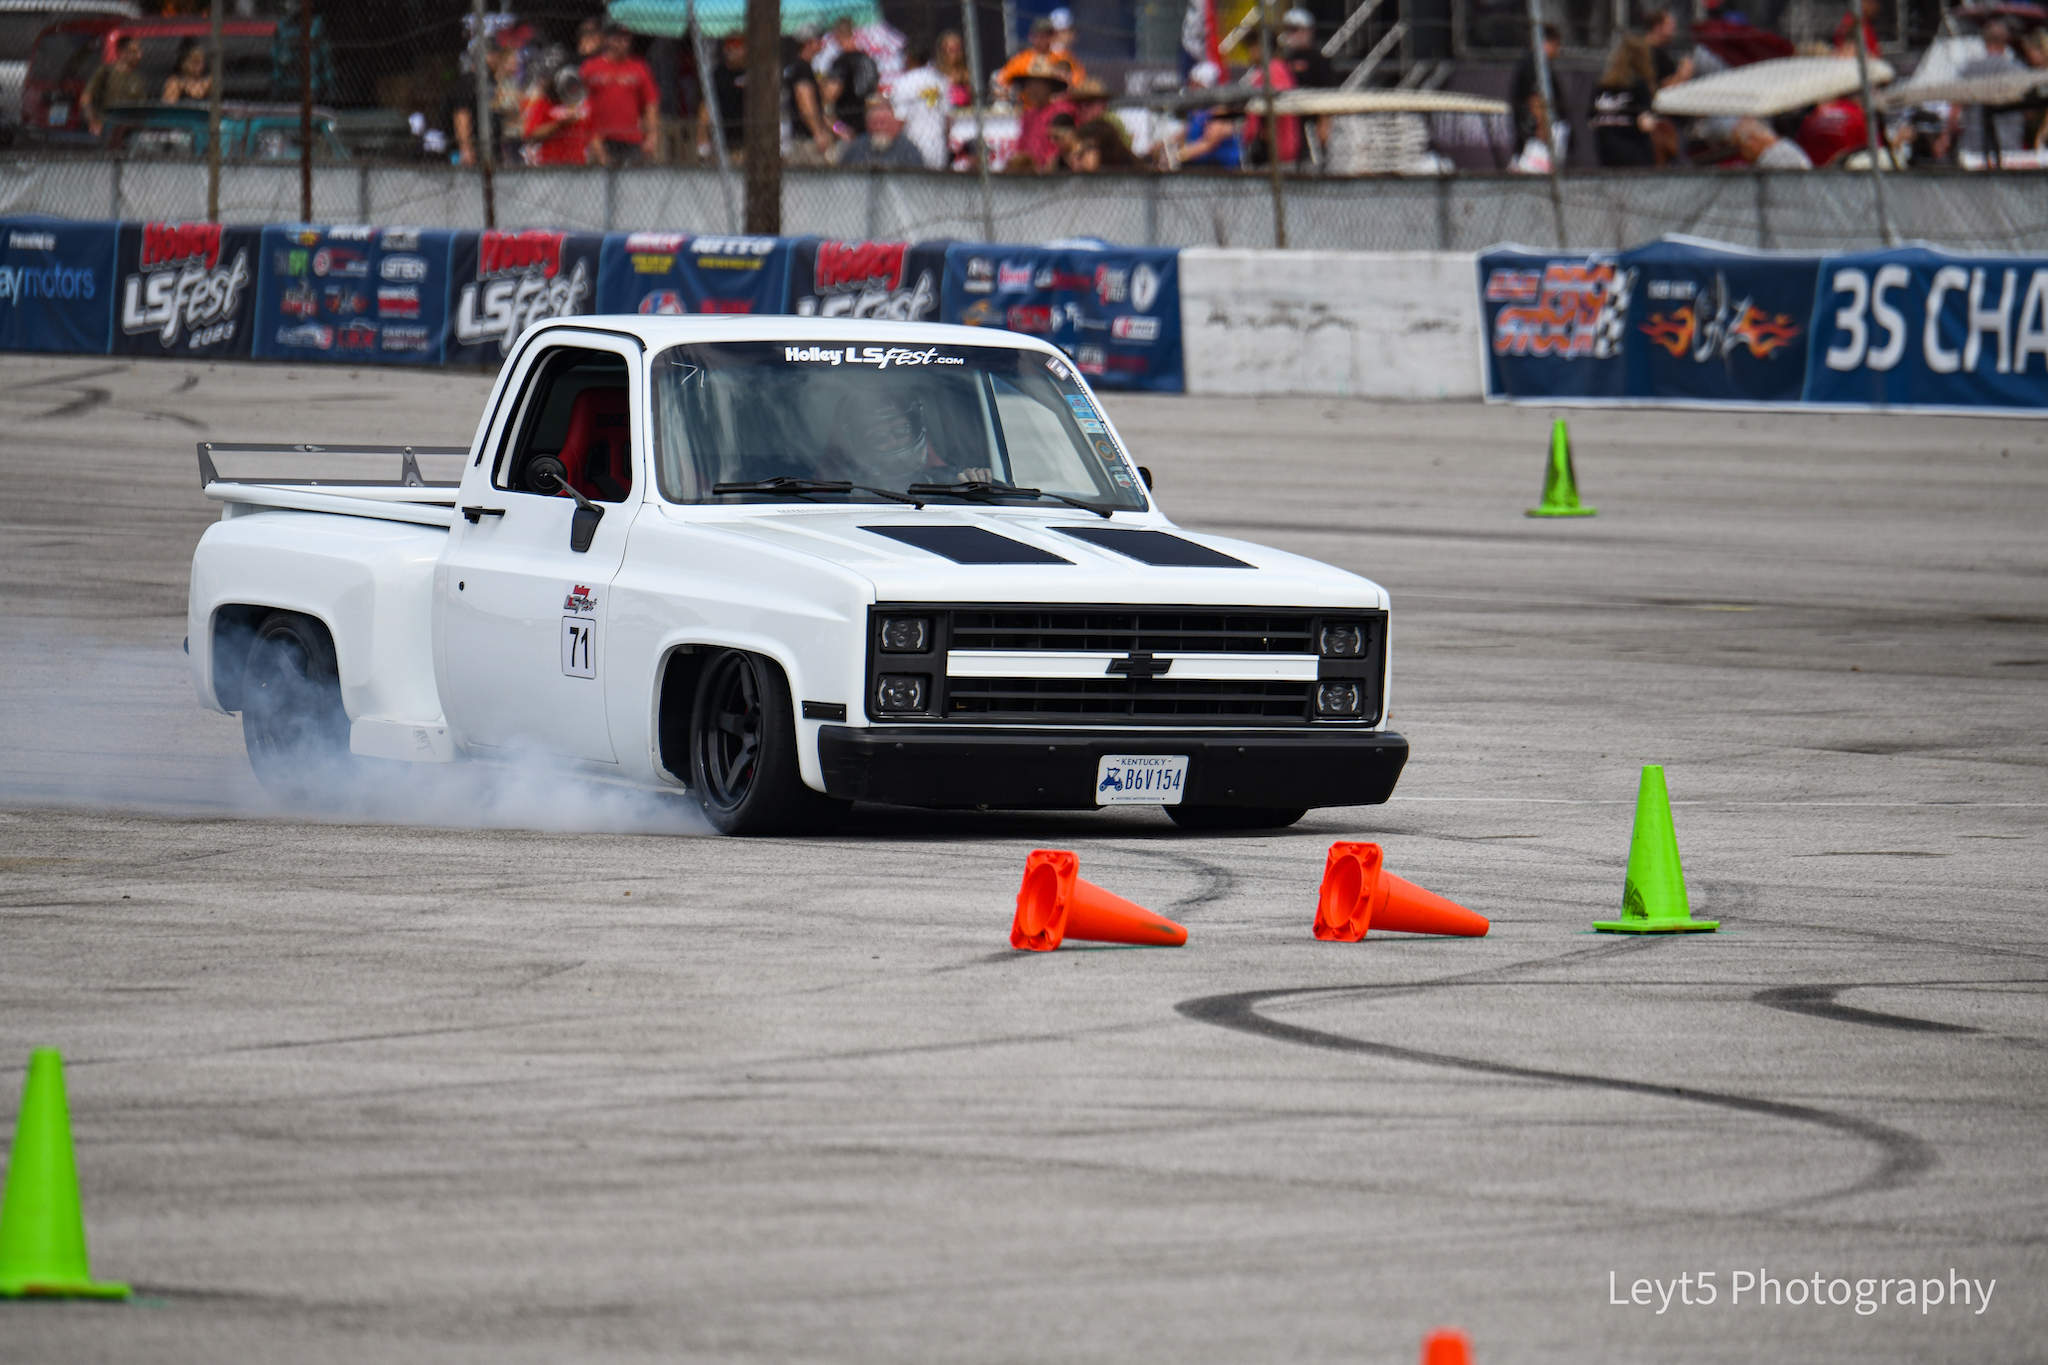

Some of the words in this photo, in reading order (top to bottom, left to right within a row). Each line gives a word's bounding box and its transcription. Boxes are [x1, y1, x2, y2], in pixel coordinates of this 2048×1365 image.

[1825, 263, 1911, 372] 3S
[784, 346, 843, 366] Holley
[569, 626, 589, 669] 71
[1121, 758, 1168, 766] KENTUCKY
[1125, 768, 1182, 790] B6V154
